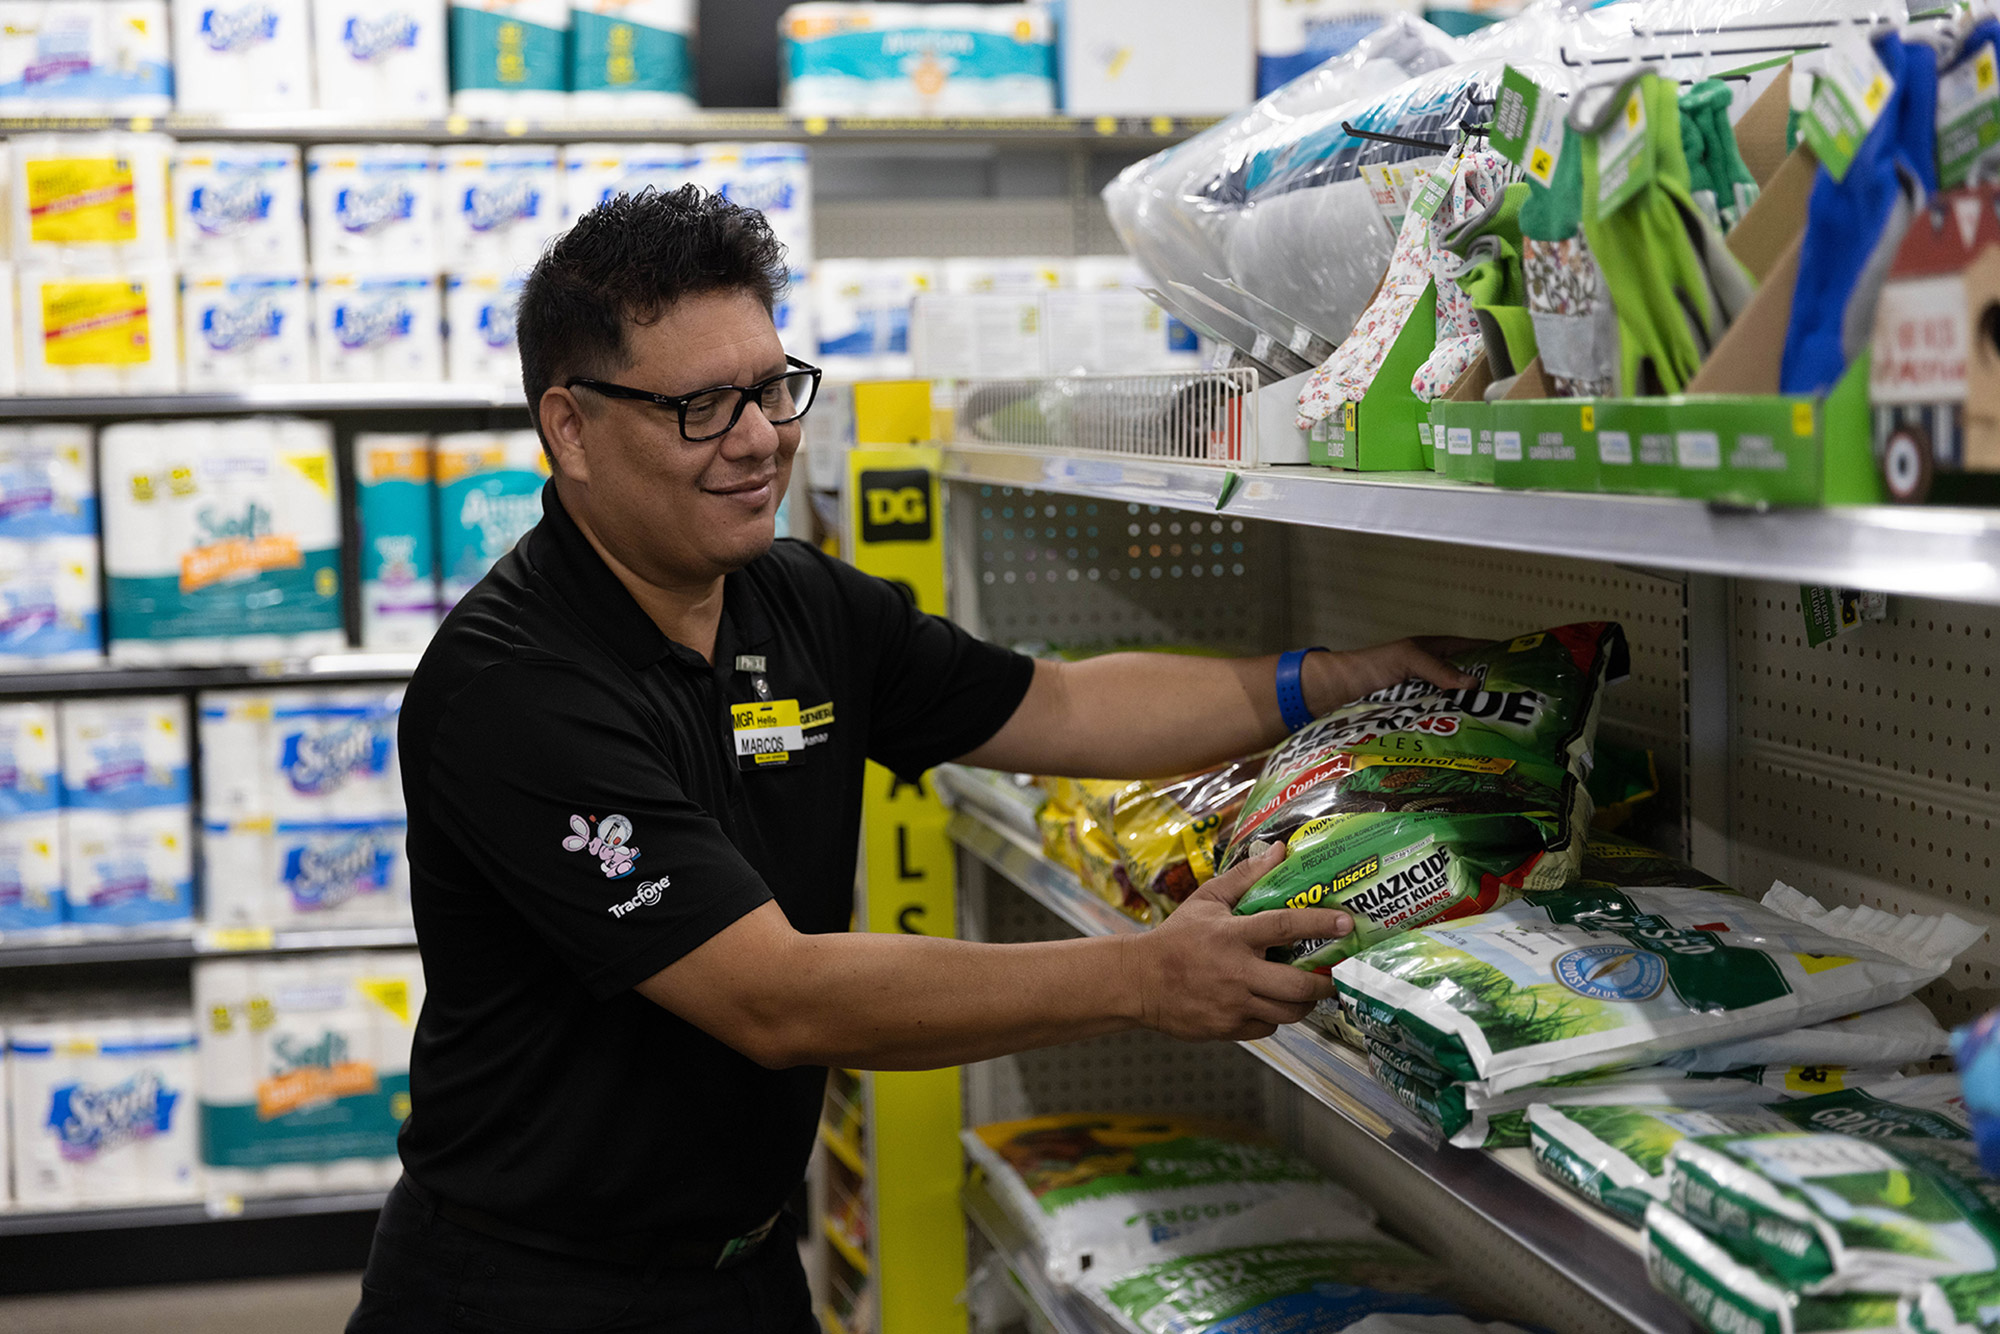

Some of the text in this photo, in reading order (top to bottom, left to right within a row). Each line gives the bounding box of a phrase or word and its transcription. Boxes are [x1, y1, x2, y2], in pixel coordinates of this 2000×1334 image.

[865, 486, 927, 525] DG
[732, 711, 777, 729] MGR Hello
[741, 736, 785, 753] MARCOS
[1286, 761, 1345, 800] Contact
[1332, 858, 1379, 893] Insects
[1341, 845, 1450, 914] TRIAZICIDE
[608, 876, 671, 919] Tracfone
[1367, 872, 1449, 923] INSECT KILLER
[1384, 911, 1408, 929] FOR
[1409, 888, 1451, 916] LAWNS
[1587, 986, 1620, 999] PLUS
[1810, 1107, 1910, 1138] GRASS
